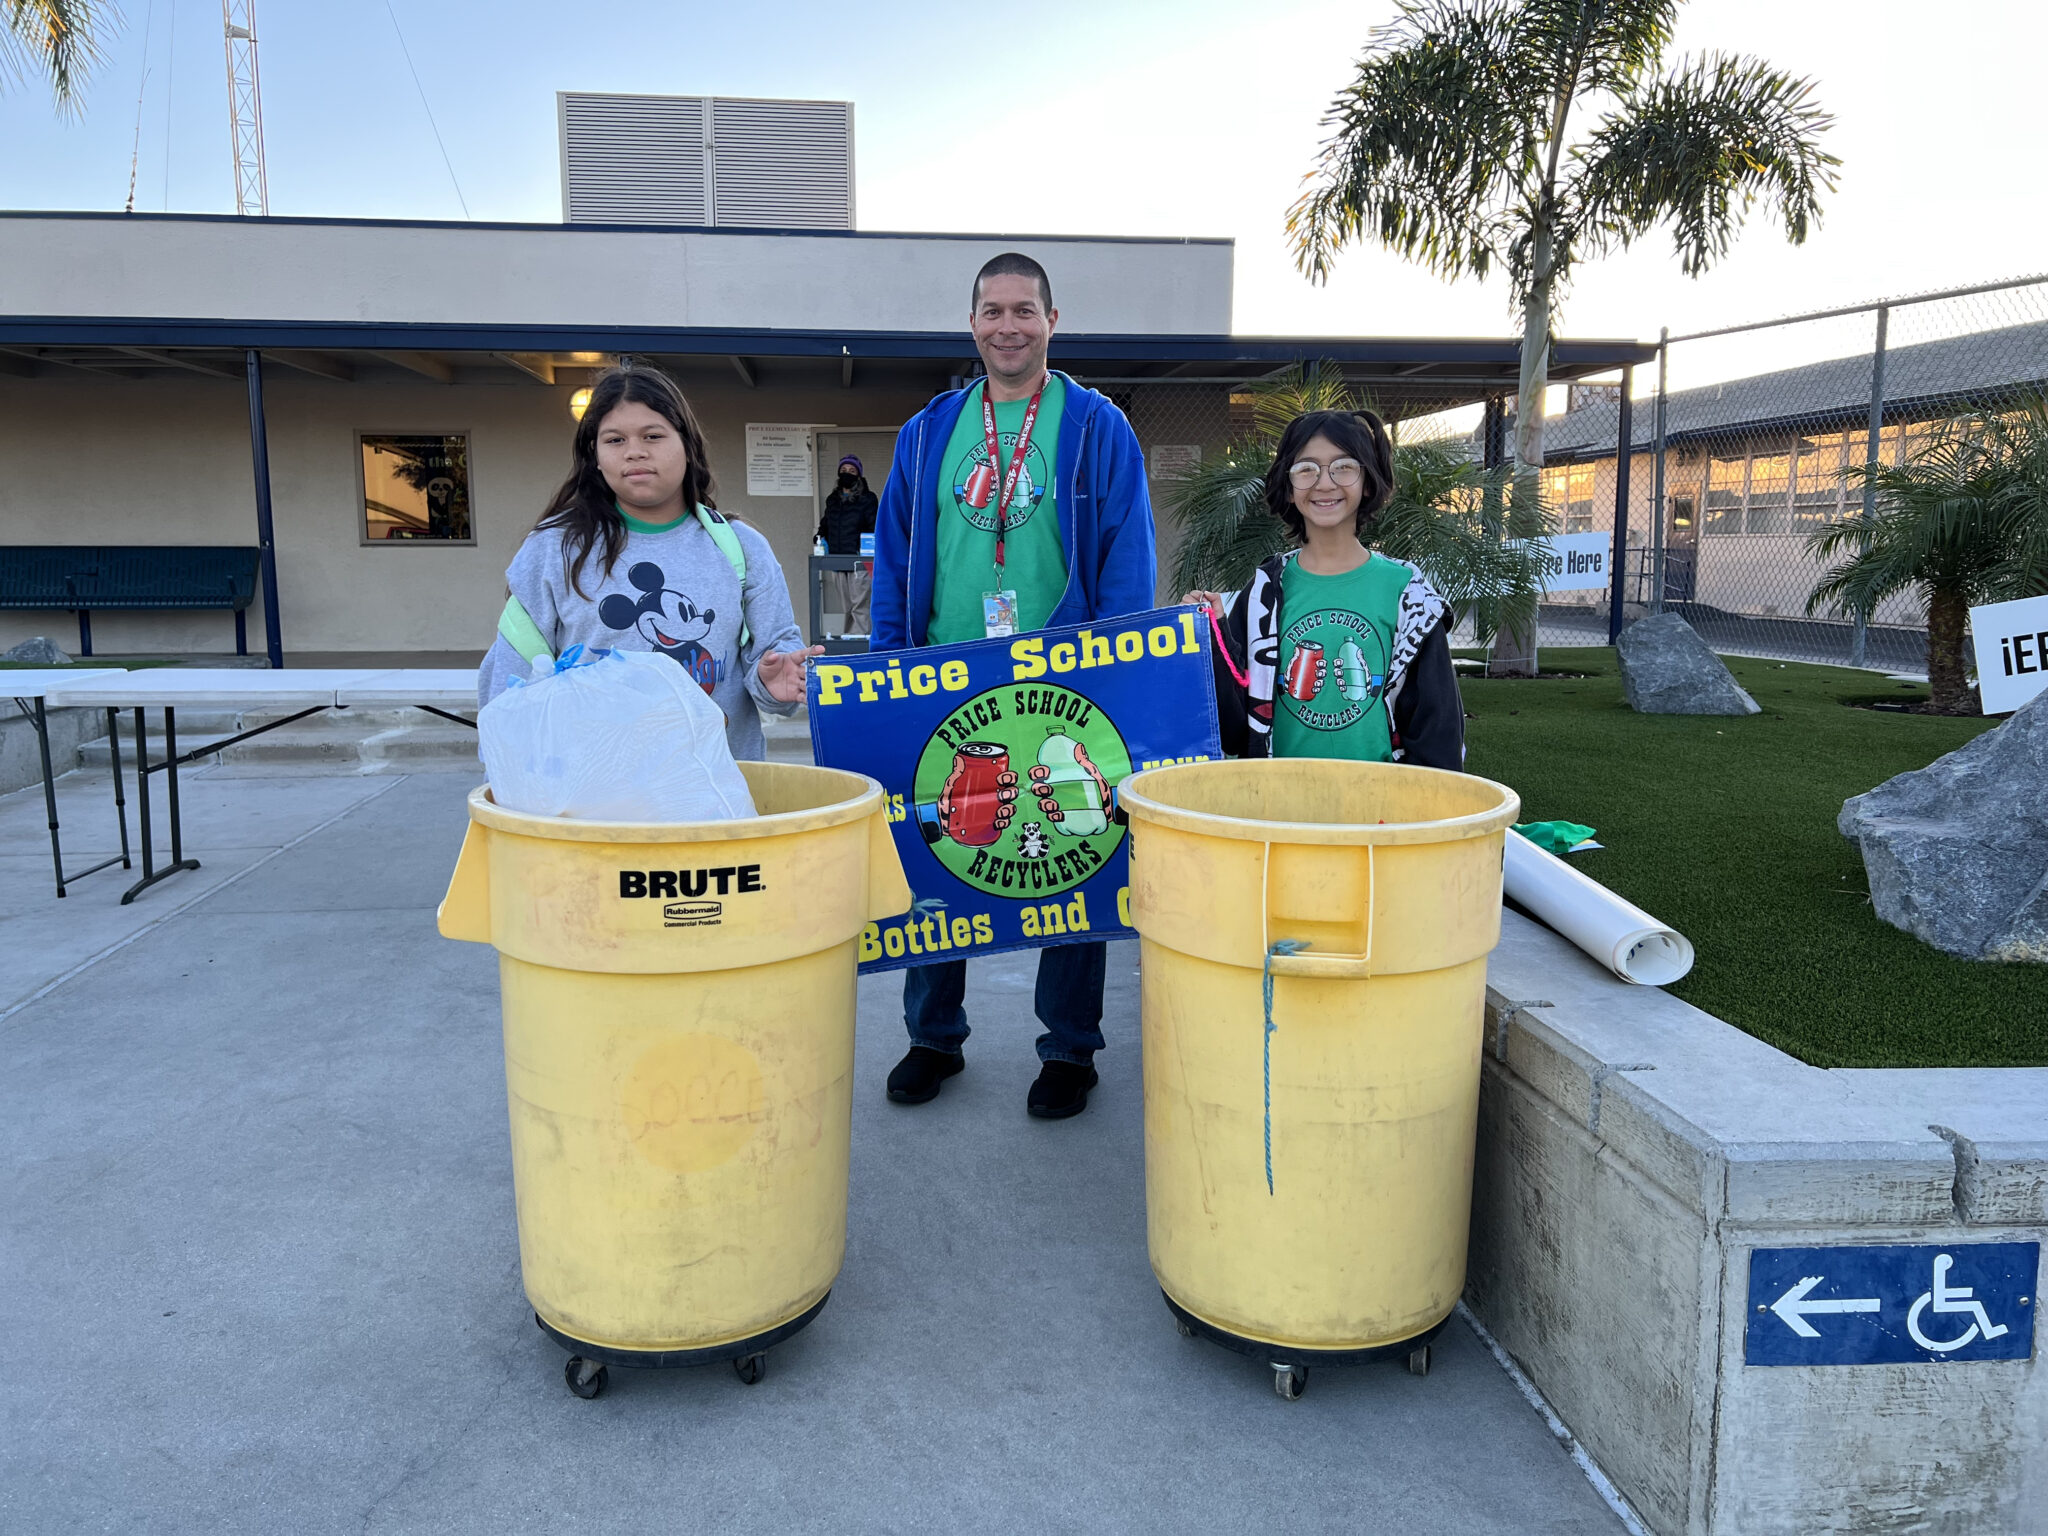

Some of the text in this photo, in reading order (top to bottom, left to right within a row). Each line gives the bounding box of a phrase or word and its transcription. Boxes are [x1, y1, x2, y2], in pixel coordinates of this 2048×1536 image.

[1003, 434, 1037, 459] SCOL
[1567, 550, 1602, 574] Here
[1287, 612, 1373, 644] PRICE SCHOOL
[816, 613, 1200, 706] Price School
[936, 689, 1093, 750] PRICE SCHOOL
[1297, 703, 1363, 728] RECYCLERS
[967, 839, 1103, 890] RECYCLERS
[666, 905, 719, 916] Rubbermaid
[698, 918, 721, 926] Products
[858, 911, 994, 963] Bottles
[1020, 892, 1090, 937] and
